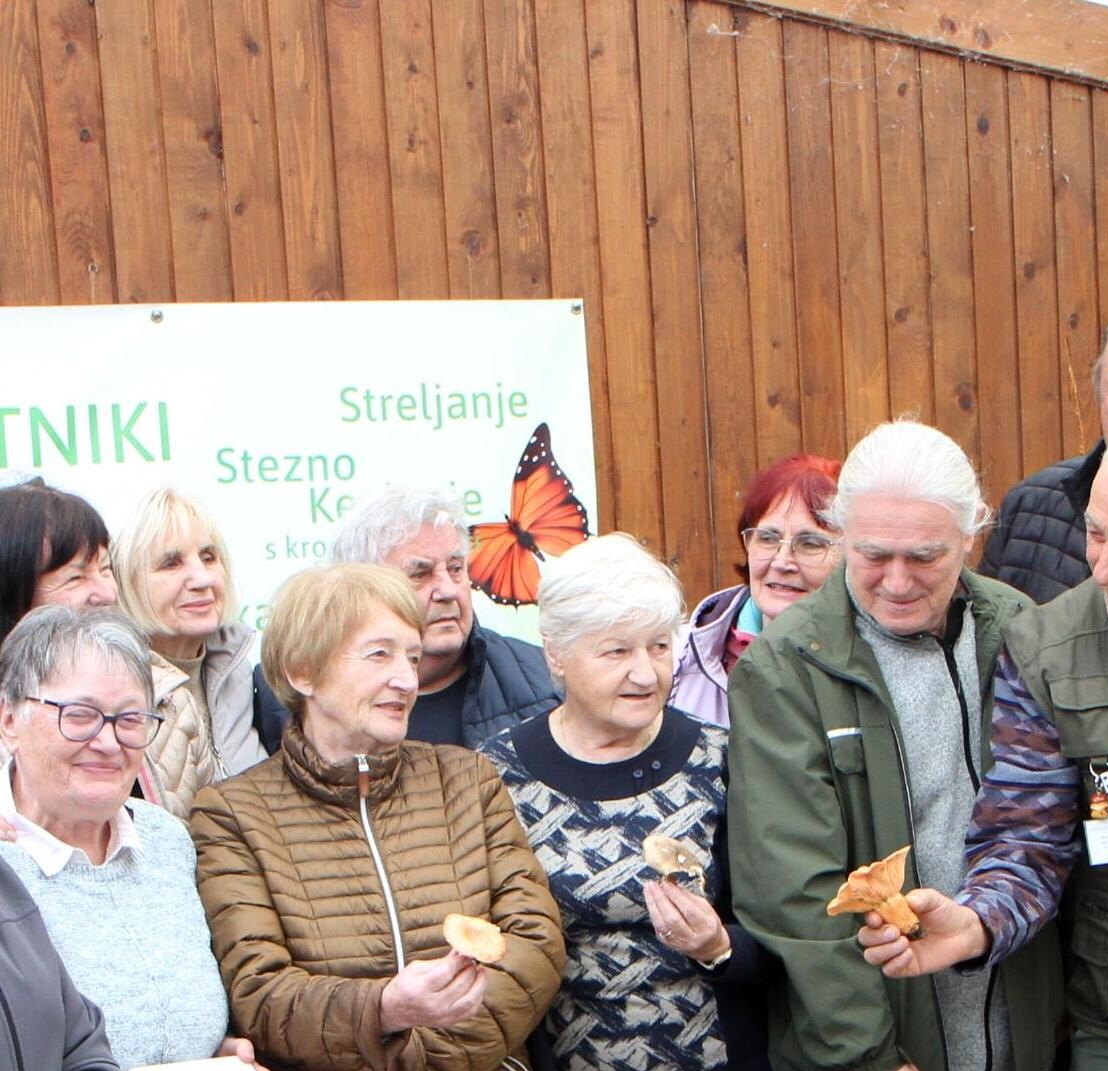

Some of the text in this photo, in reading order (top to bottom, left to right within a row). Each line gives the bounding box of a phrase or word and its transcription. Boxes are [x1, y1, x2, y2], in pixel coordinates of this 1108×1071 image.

[339, 382, 528, 430] Streljanje
[216, 447, 356, 484] Stezno
[265, 542, 277, 560] s
